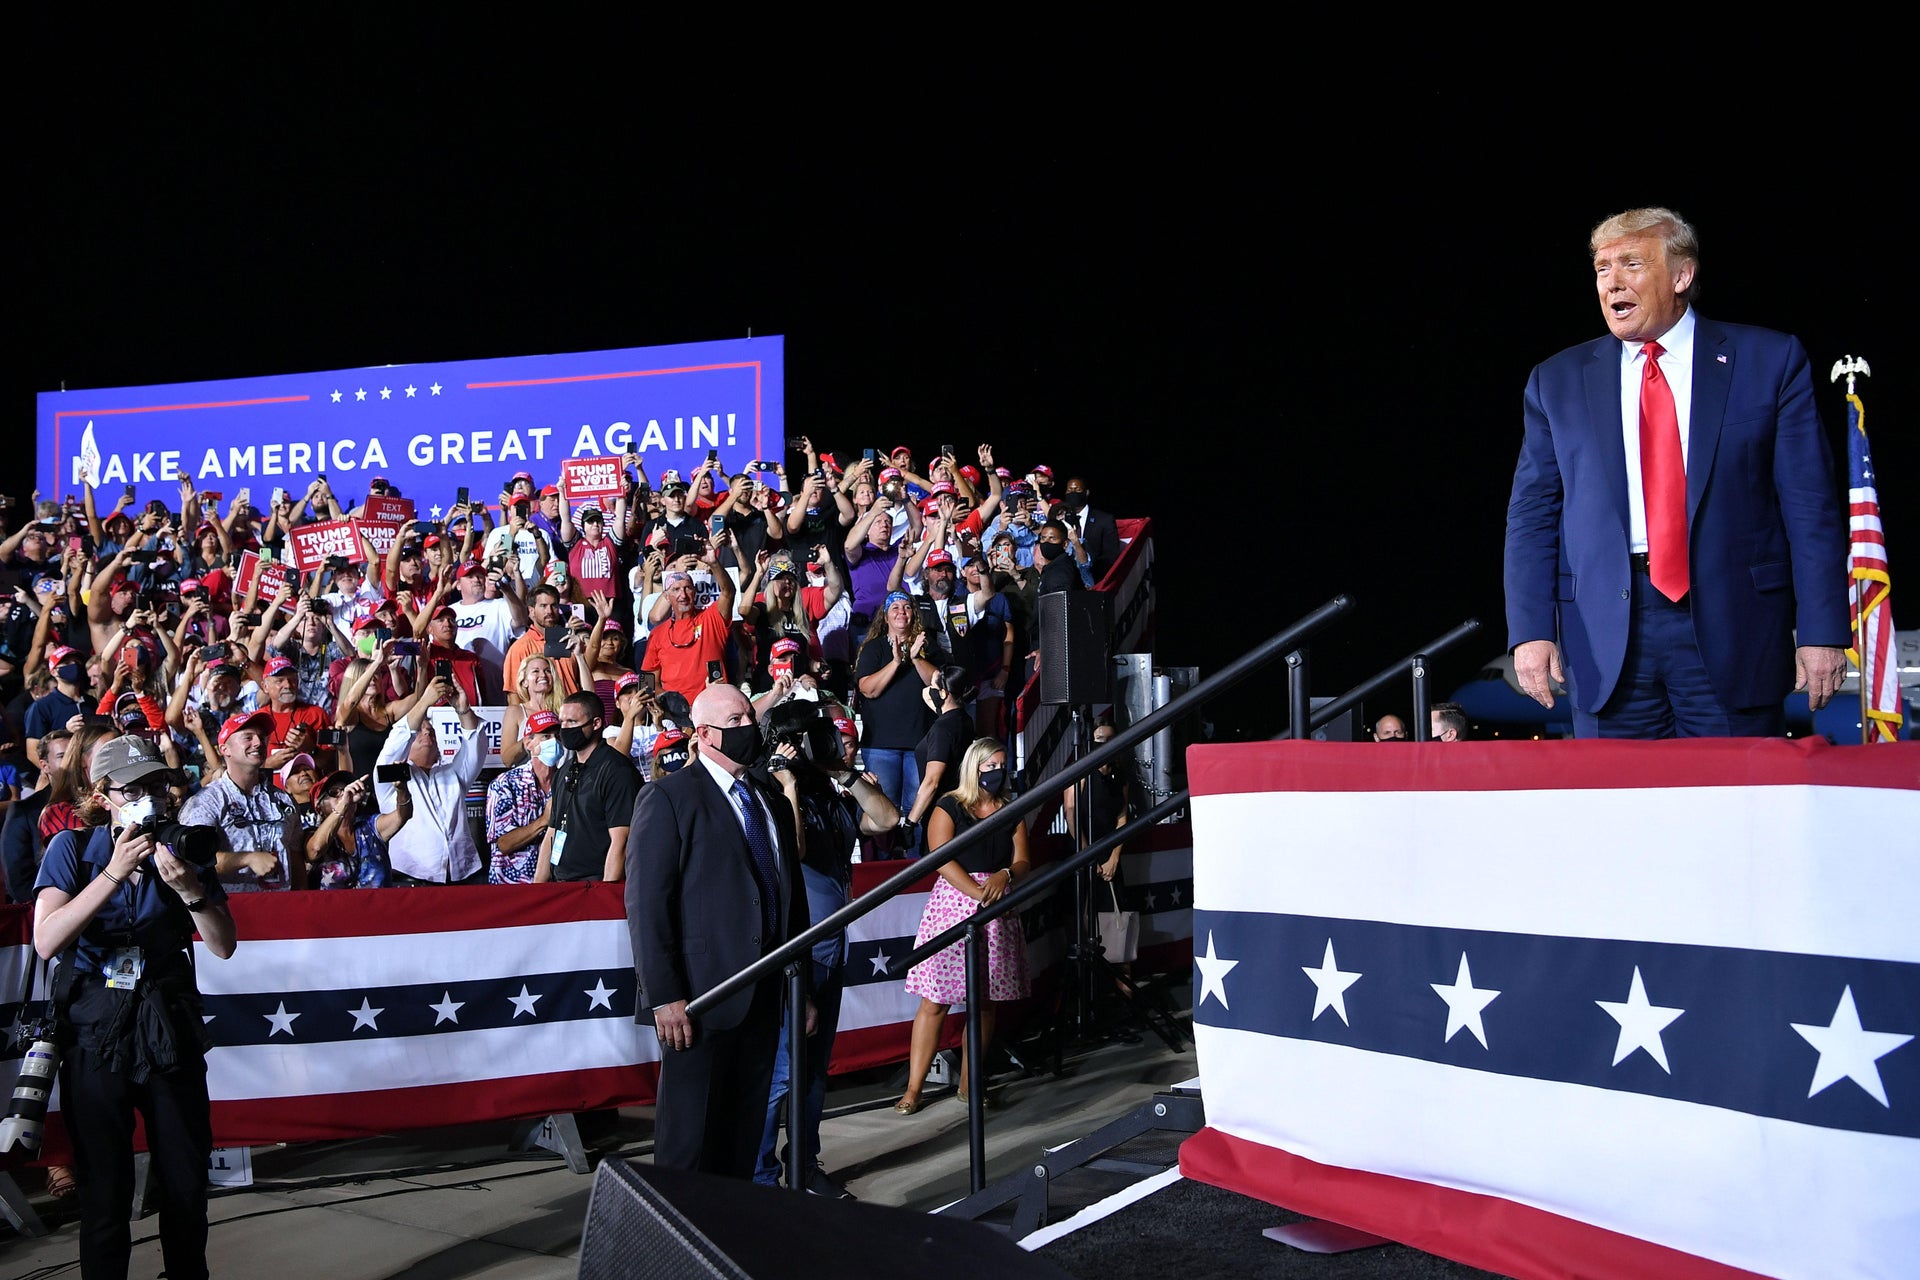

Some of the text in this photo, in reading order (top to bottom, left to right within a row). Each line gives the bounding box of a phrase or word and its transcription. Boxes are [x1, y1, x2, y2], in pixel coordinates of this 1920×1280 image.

[198, 438, 389, 479] AMERICA
[407, 428, 551, 466] GREAT
[571, 413, 736, 457] AGAIN!
[568, 463, 615, 477] TRUMP
[580, 474, 617, 486] VOTE
[382, 503, 402, 512] TEXT
[377, 512, 405, 521] TRUMP
[297, 526, 351, 547] TRUMP
[360, 527, 396, 538] RUMP
[313, 537, 356, 556] VOTE
[600, 546, 612, 578] TRUMP
[267, 567, 286, 579] EXT
[260, 574, 283, 587] RUM
[456, 615, 486, 628] 020
[442, 722, 502, 734] TRMP
